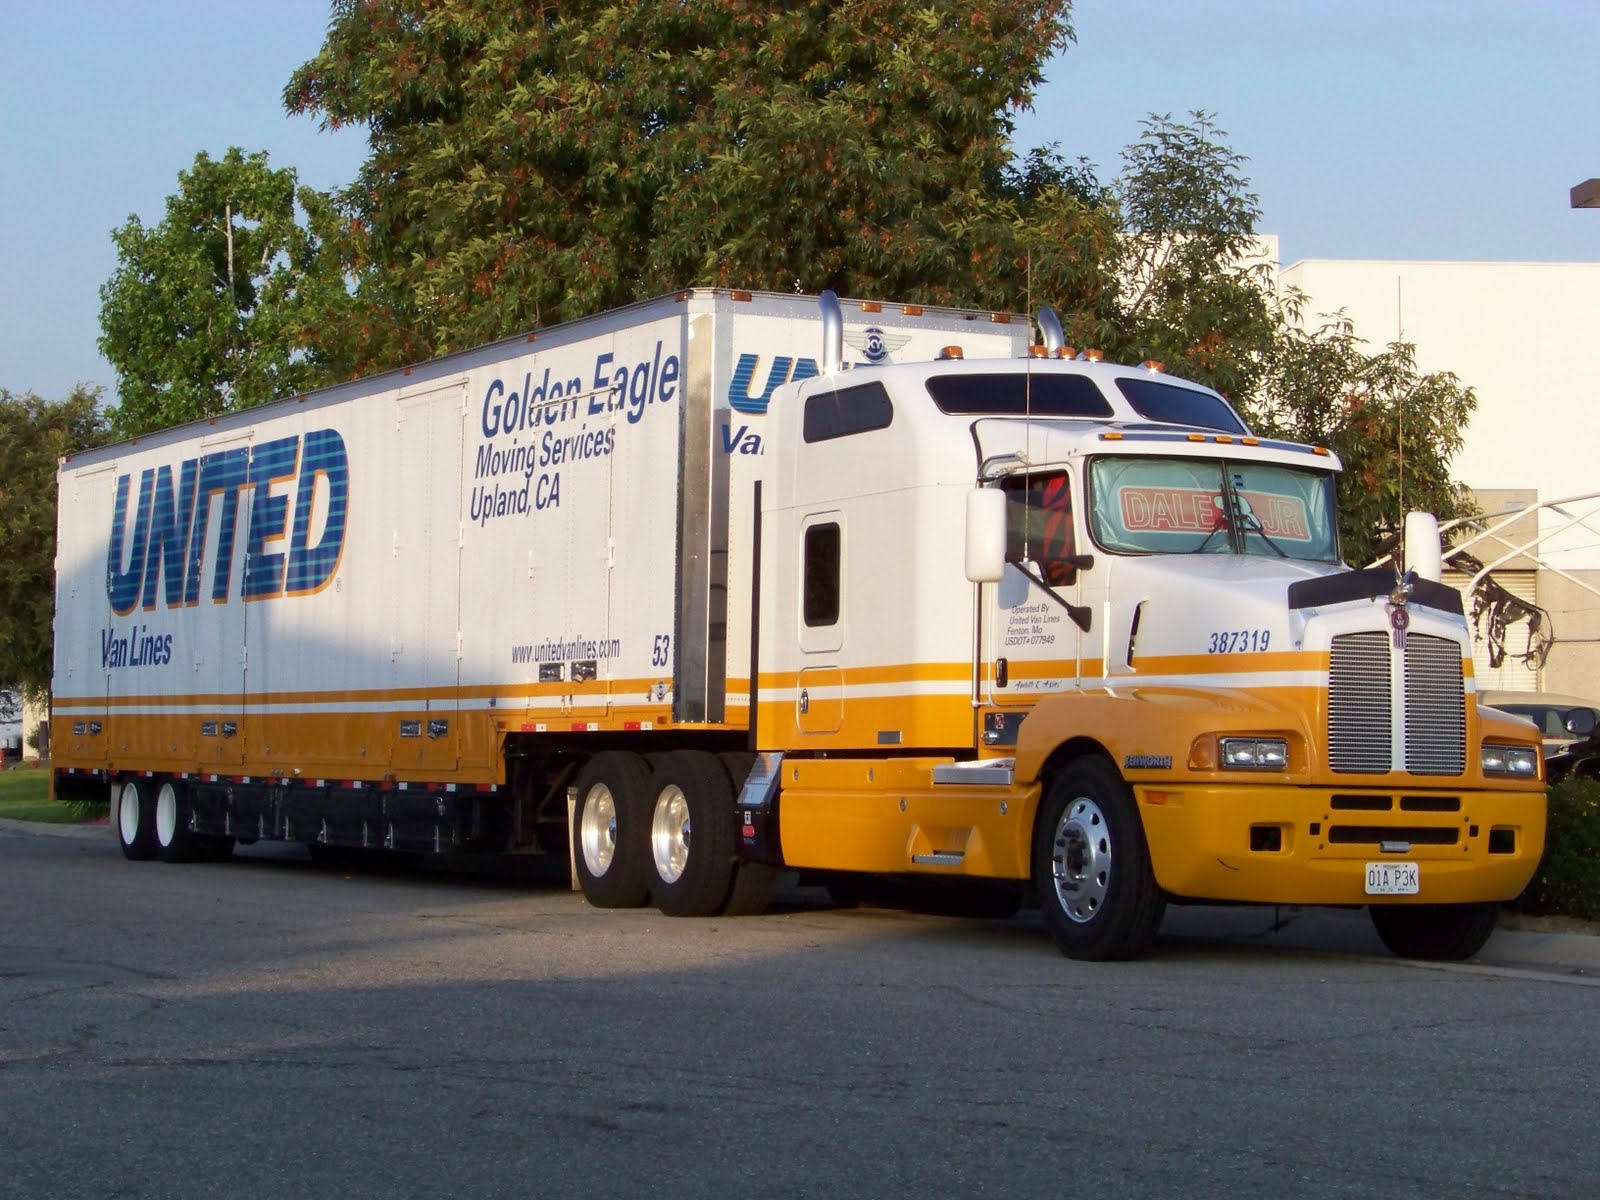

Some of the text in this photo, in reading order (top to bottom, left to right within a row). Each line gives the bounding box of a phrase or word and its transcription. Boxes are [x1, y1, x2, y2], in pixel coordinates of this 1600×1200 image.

[482, 368, 582, 438] Golden
[588, 341, 679, 424] Eagle
[475, 424, 616, 478] Moving Services
[721, 424, 765, 455] Va
[470, 472, 560, 527] Upland, CA
[1123, 491, 1304, 537] DALE JR
[107, 428, 350, 617] UNITED
[1009, 615, 1061, 625] United Van Lines
[1011, 603, 1050, 615] Operated By
[1031, 625, 1043, 634] Mo
[1208, 630, 1271, 654] 387319
[101, 625, 173, 668] Van Lines
[512, 634, 620, 664] www.unitedvanlines.com
[652, 635, 670, 667] 53
[1125, 754, 1172, 768] KENWORTH
[1394, 870, 1417, 887] P3K
